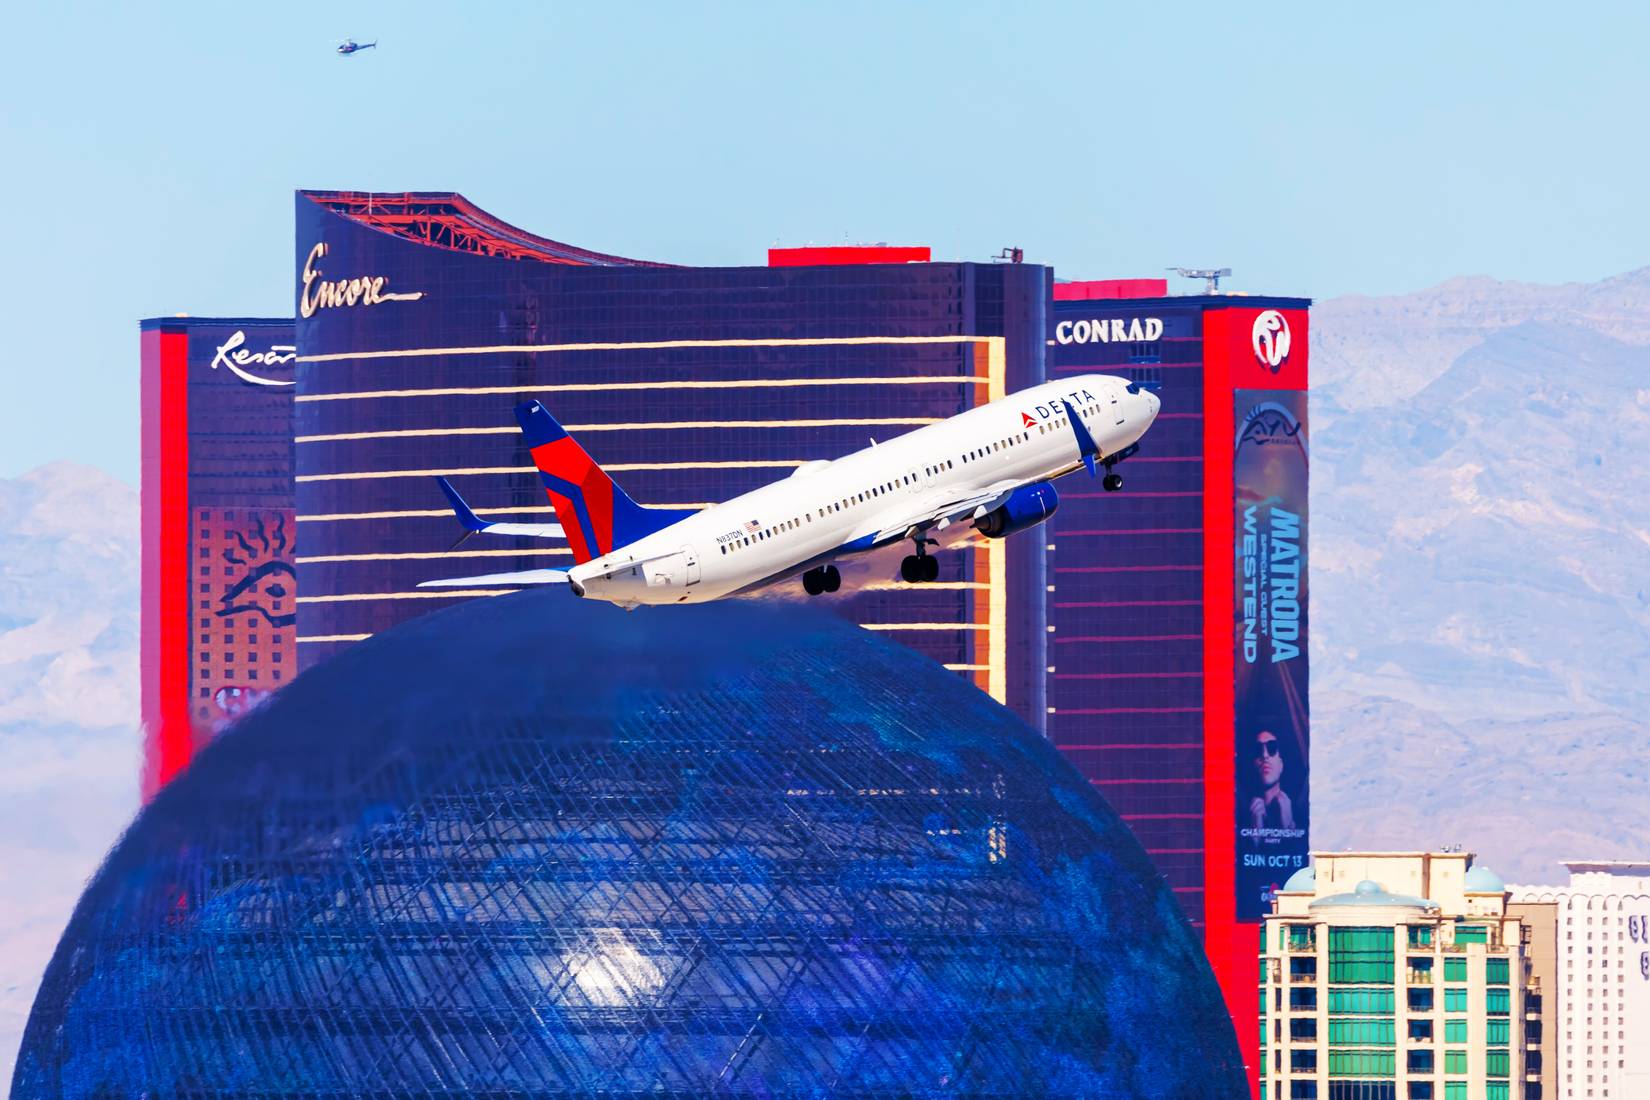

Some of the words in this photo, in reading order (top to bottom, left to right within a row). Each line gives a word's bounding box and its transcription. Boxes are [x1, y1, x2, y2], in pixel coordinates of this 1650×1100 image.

[300, 242, 422, 318] Encore
[1055, 318, 1164, 345] CONRAD
[716, 529, 744, 544] N837DN
[1243, 505, 1258, 663] WESTEND
[1270, 507, 1300, 663] MATRODA
[1240, 828, 1305, 838] CHAMPIONSHIP
[1243, 854, 1266, 867] SUN
[1268, 855, 1290, 868] OCT
[1293, 855, 1303, 868] 13
